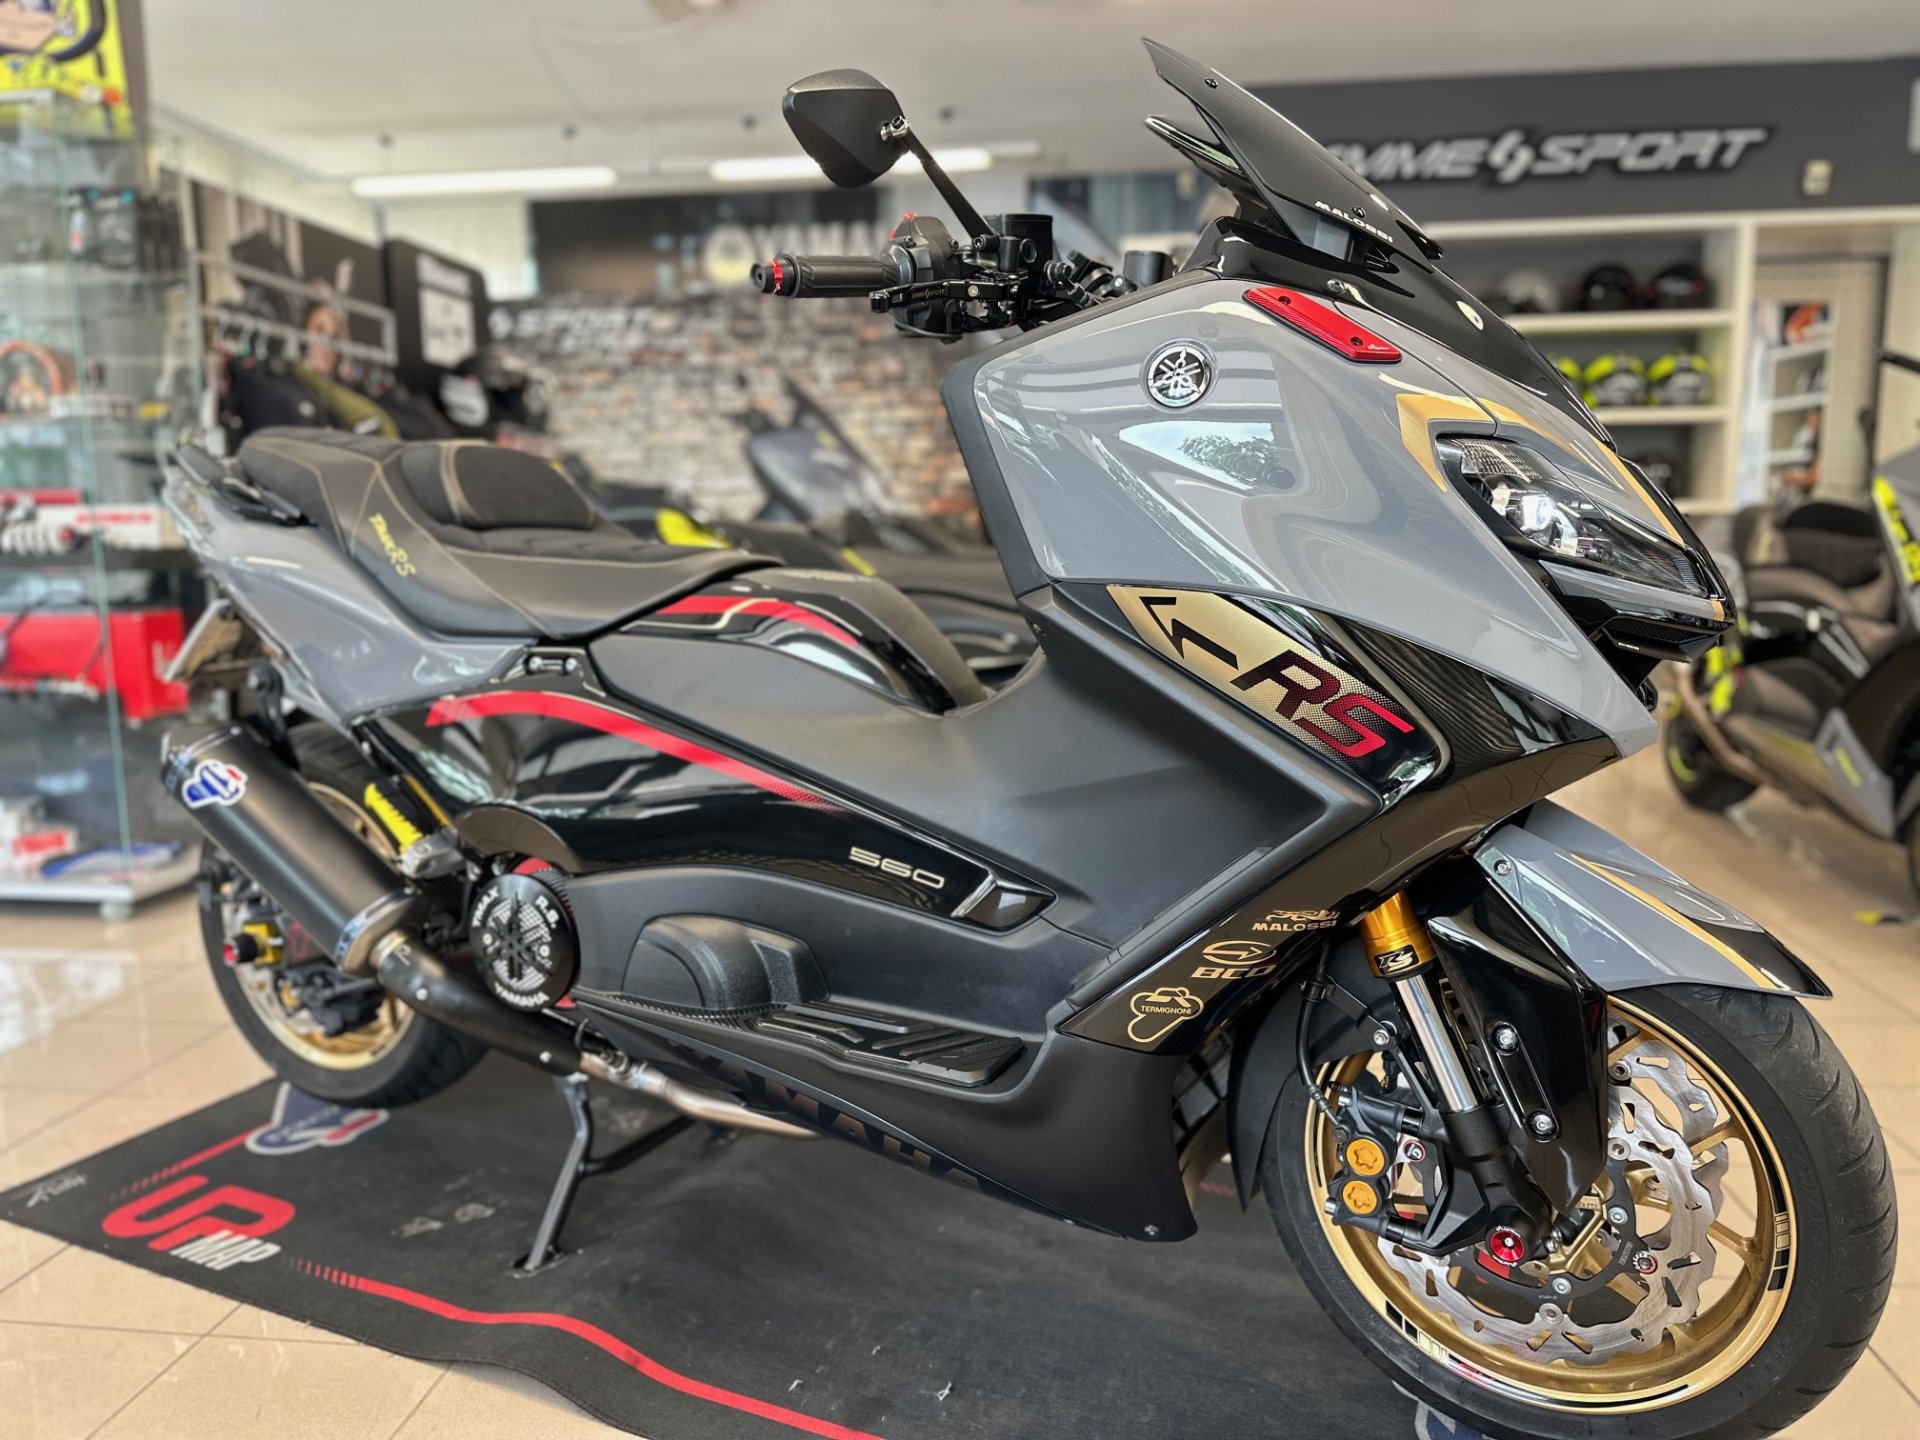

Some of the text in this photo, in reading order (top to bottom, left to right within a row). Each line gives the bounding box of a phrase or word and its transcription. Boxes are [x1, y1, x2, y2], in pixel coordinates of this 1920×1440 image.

[1530, 128, 1767, 175] SPORT
[1315, 200, 1393, 244] MALOSSI
[1230, 649, 1415, 758] RS
[849, 846, 945, 889] 560
[1251, 919, 1338, 932] MALOSSI
[494, 981, 550, 1007] YAMAHA
[1140, 1004, 1192, 1015] TERMIGNONI
[101, 1174, 296, 1251] UP
[169, 1228, 282, 1271] MAP
